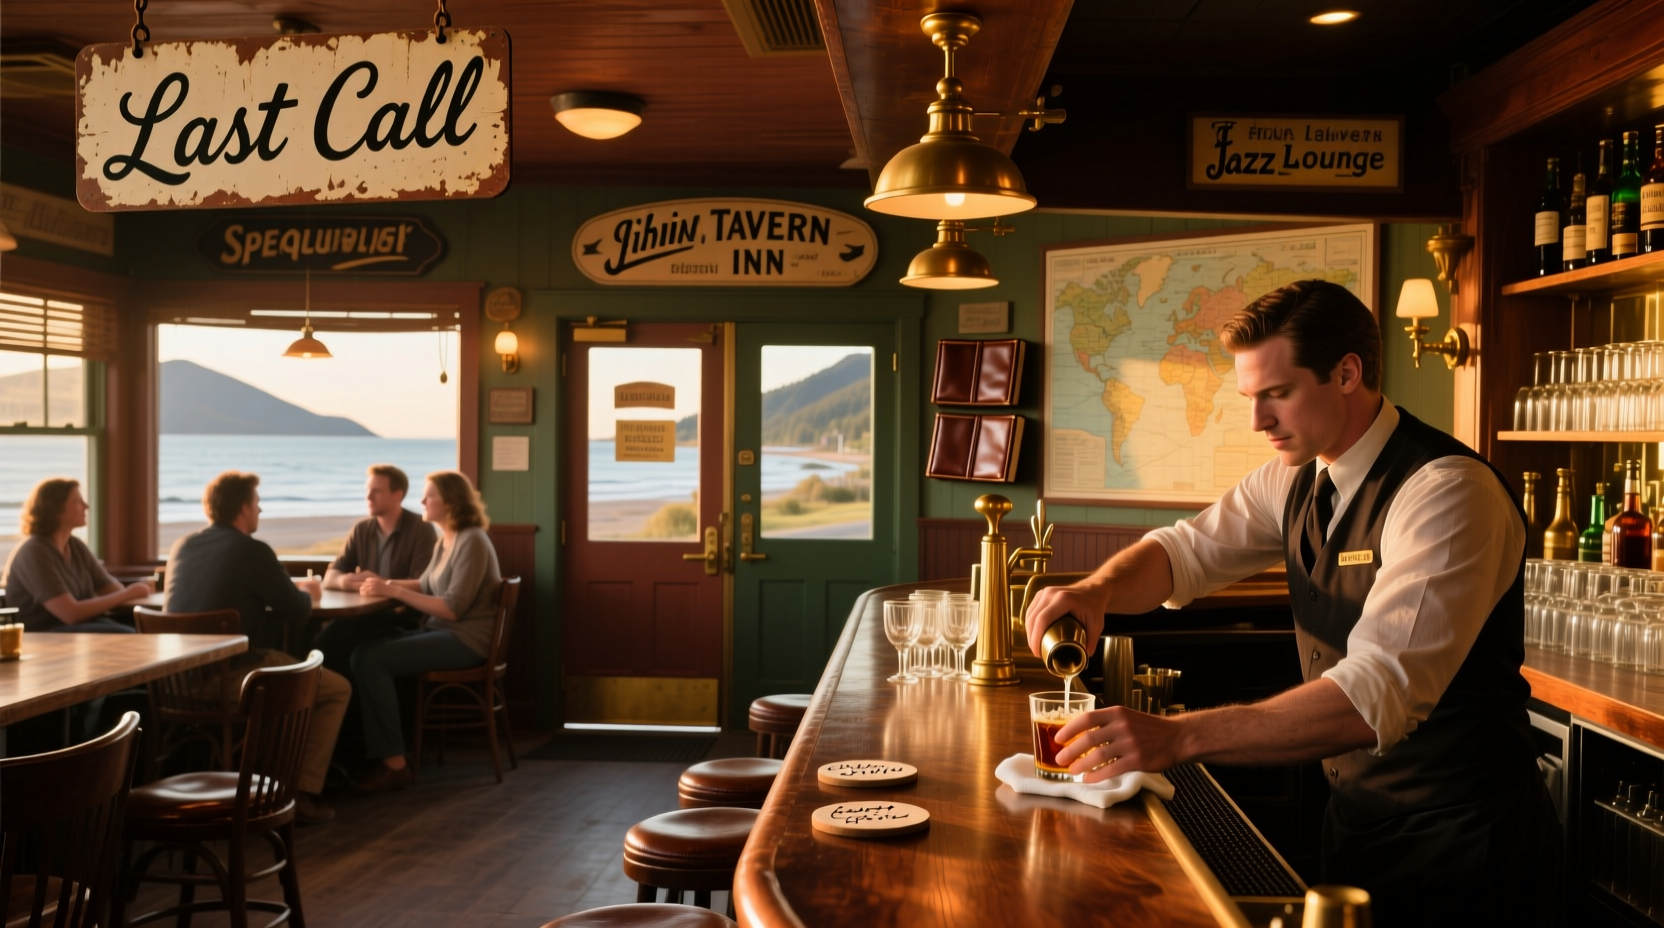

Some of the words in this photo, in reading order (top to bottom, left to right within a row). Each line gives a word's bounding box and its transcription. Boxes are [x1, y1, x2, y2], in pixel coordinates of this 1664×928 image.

[103, 72, 299, 186] Last
[313, 55, 485, 161] Call
[1281, 144, 1385, 178] Lounge
[710, 208, 831, 246] TAVERN
[731, 249, 784, 276] INN
